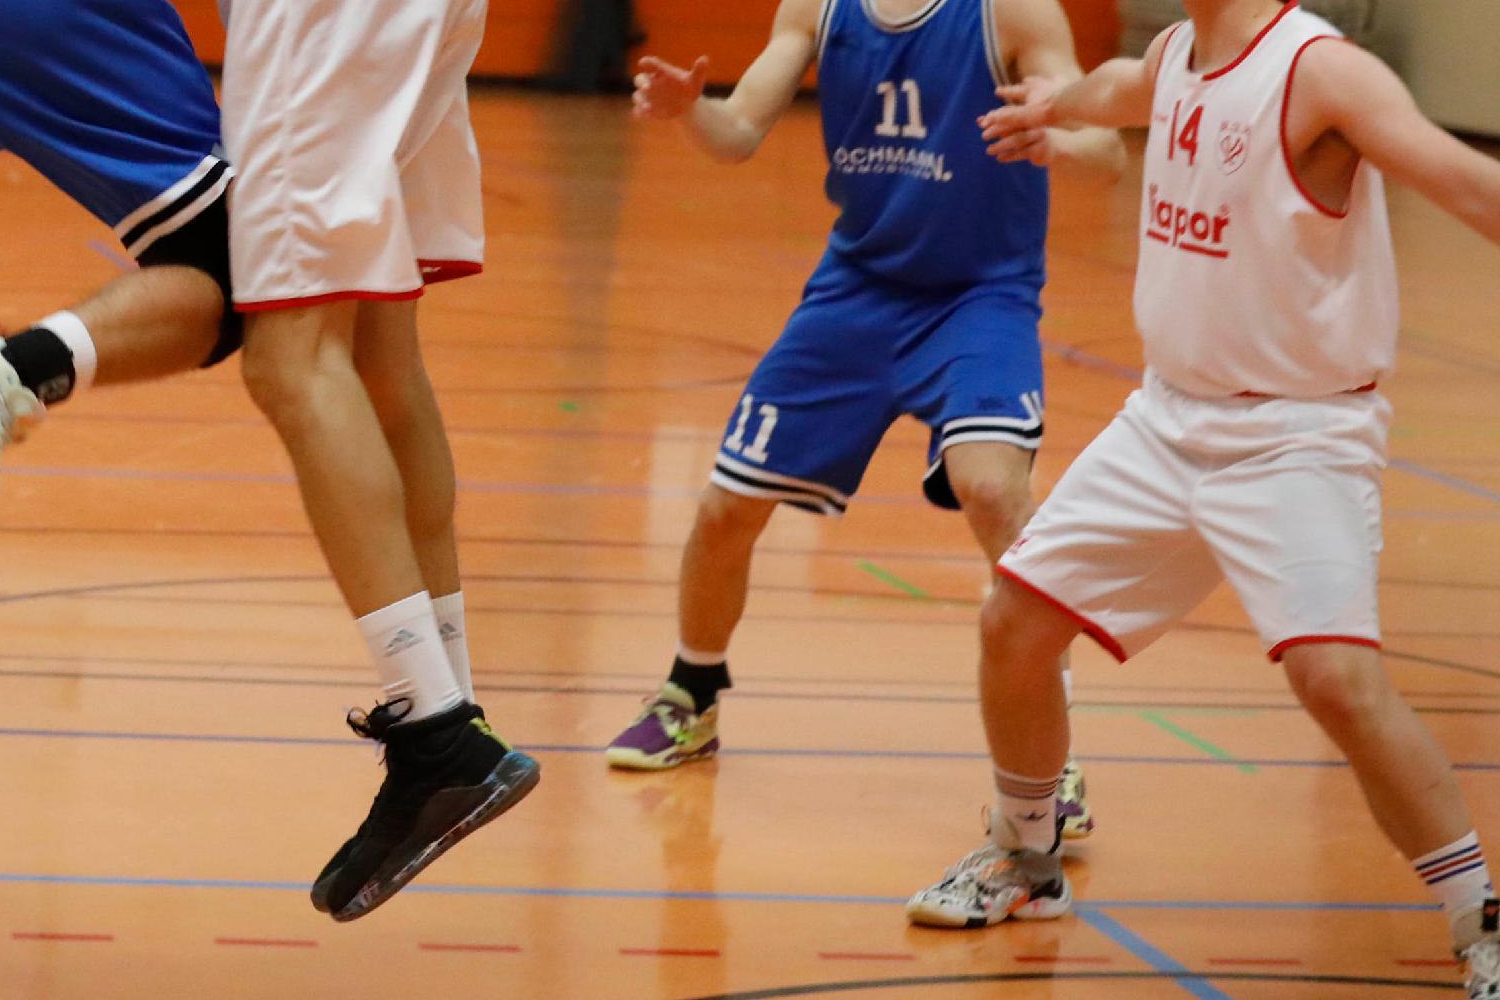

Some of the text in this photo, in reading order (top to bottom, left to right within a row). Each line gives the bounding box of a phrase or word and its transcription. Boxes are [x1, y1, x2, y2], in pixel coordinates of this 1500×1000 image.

[875, 79, 927, 138] 11
[1168, 100, 1204, 167] 14
[1149, 184, 1229, 248] iapor
[724, 393, 778, 464] 11
